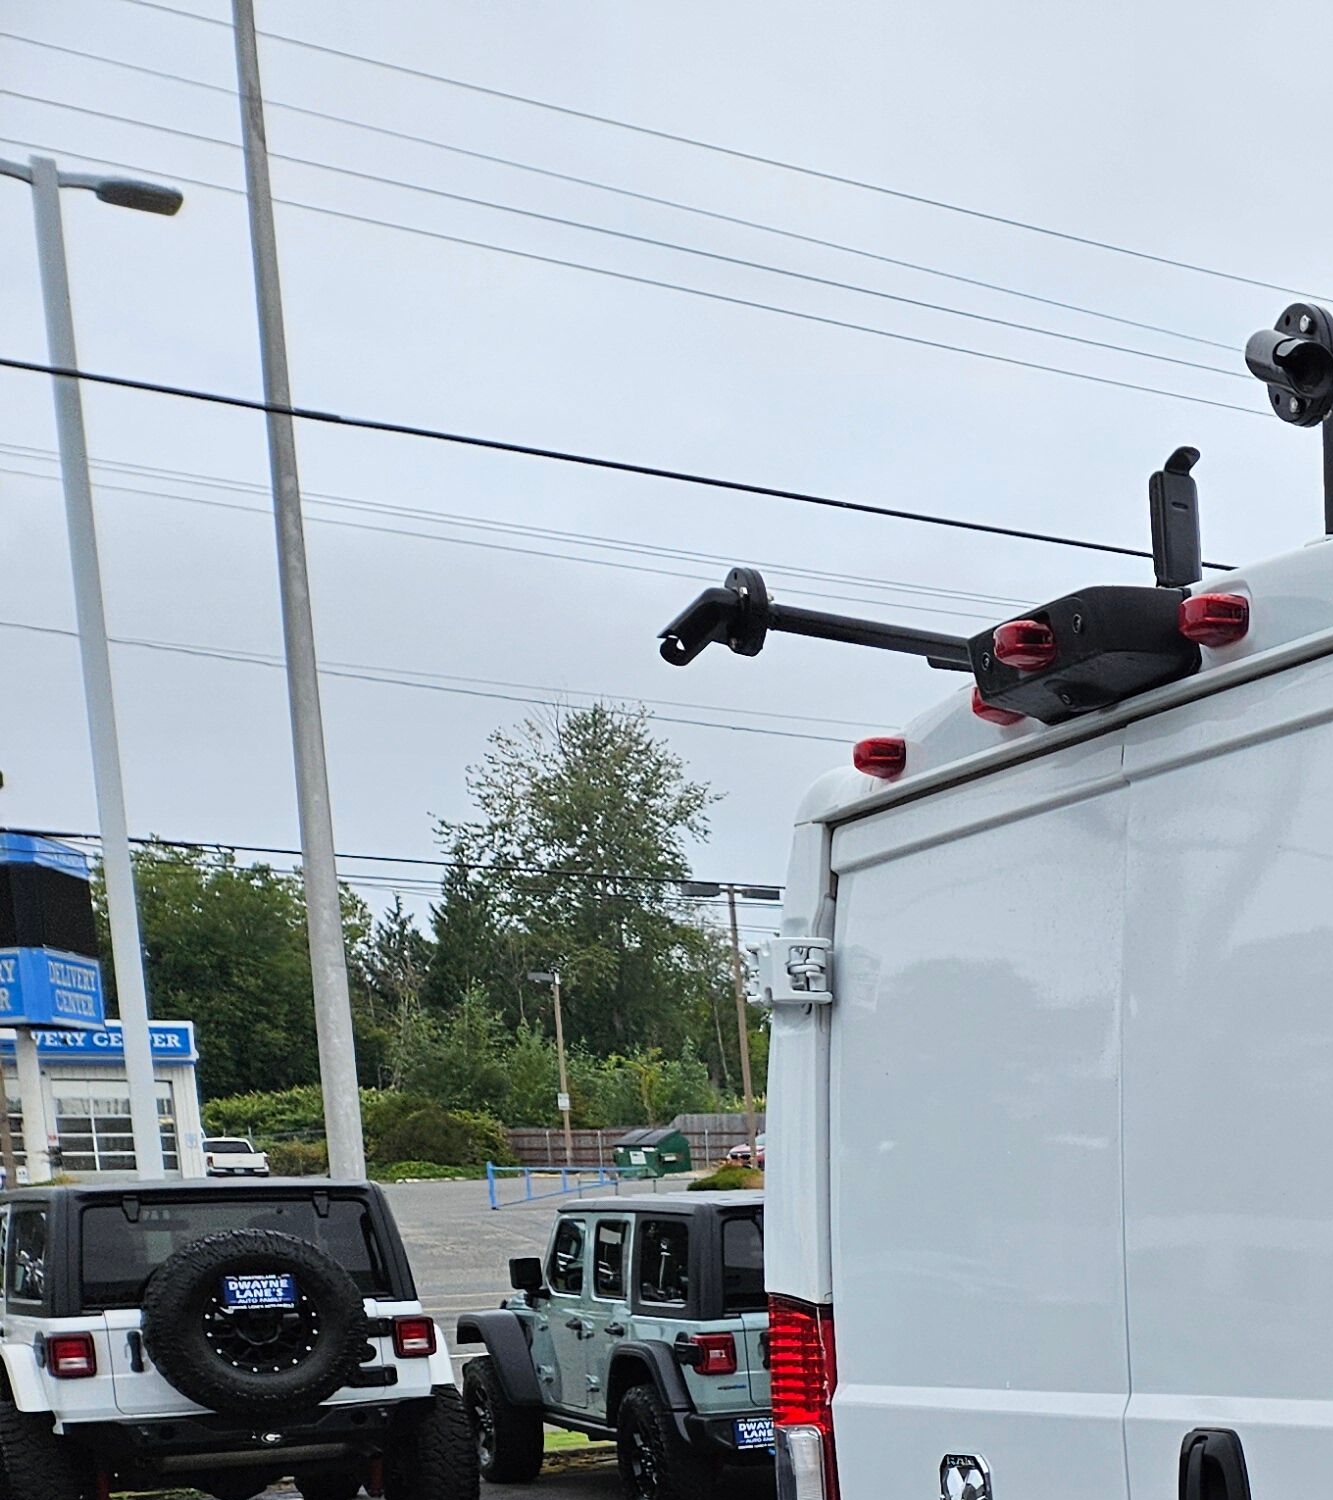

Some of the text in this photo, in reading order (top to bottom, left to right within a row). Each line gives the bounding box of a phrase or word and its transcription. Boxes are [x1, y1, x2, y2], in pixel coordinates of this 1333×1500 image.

[48, 960, 97, 991] DELIVERY
[55, 989, 97, 1016] CENTER
[228, 1279, 289, 1290] DWAYNE
[236, 1288, 284, 1298] LANE'S
